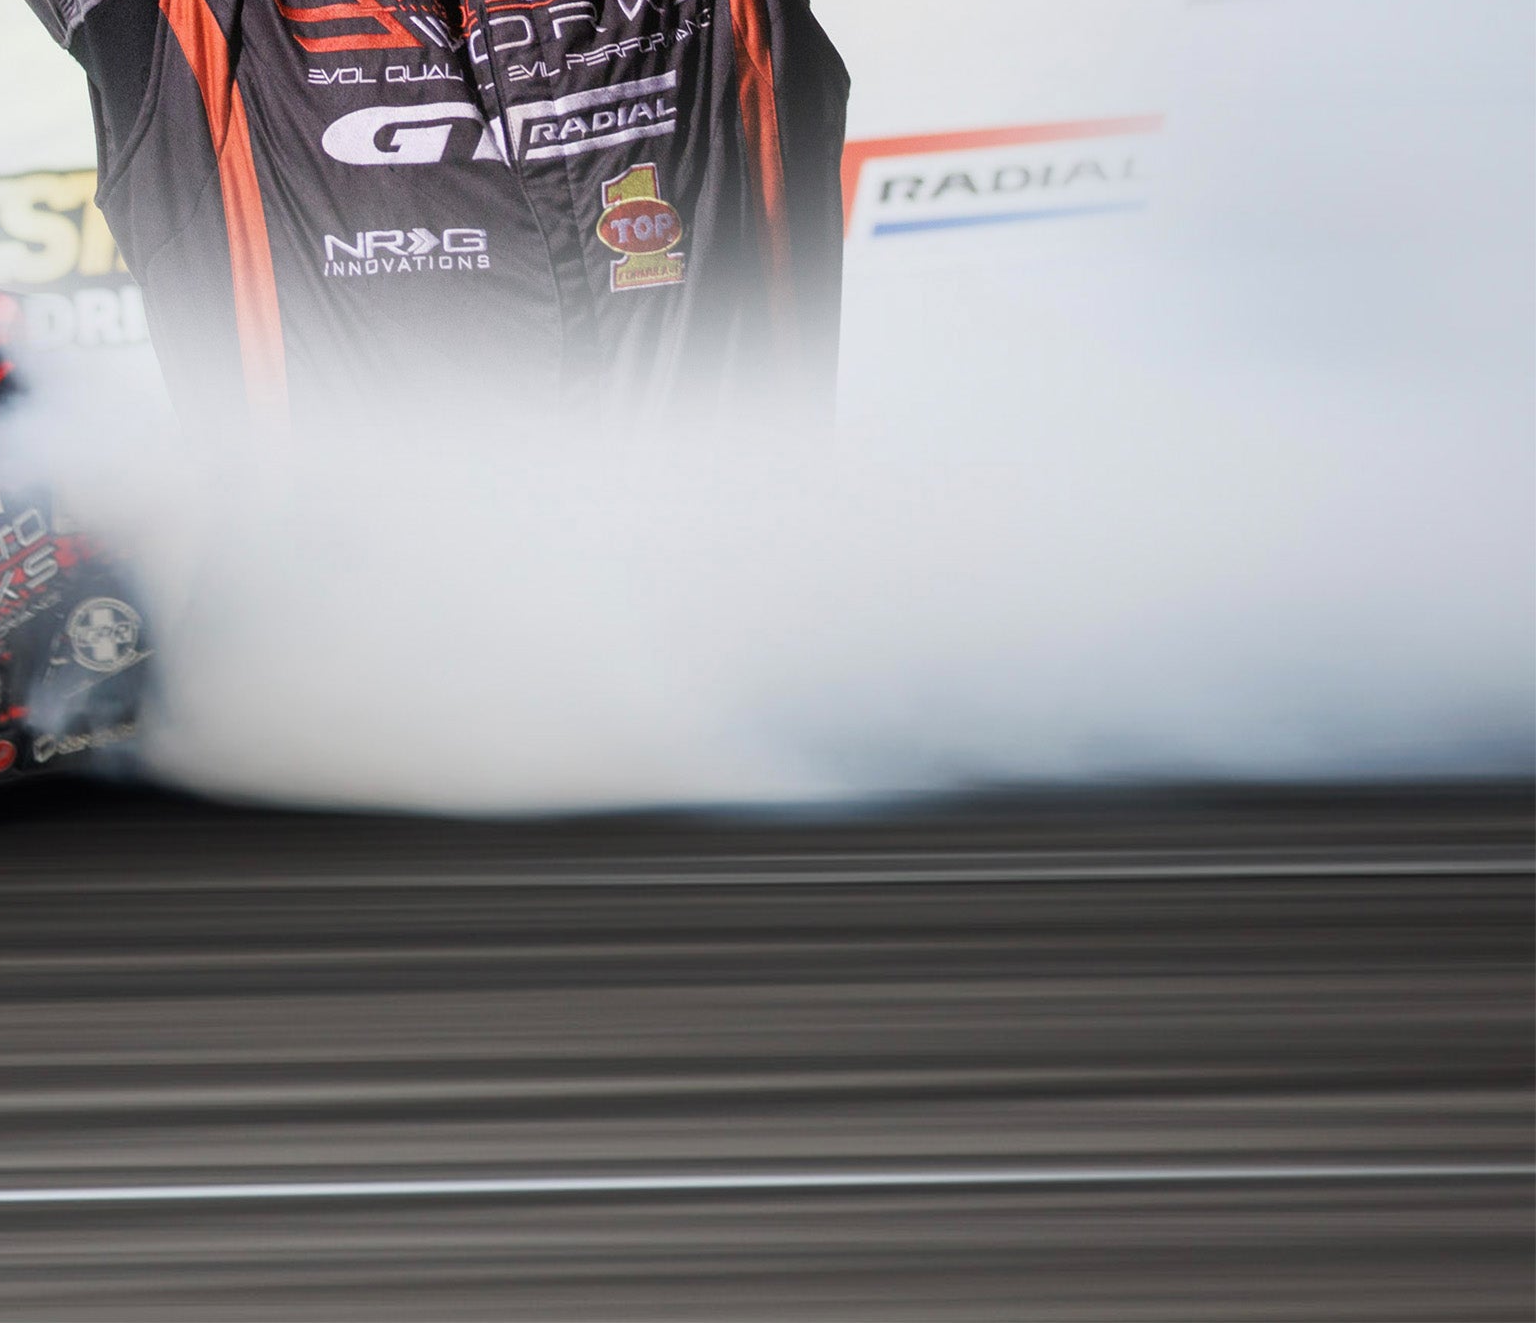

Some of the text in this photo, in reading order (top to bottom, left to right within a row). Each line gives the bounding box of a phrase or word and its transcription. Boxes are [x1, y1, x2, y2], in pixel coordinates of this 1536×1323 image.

[307, 67, 377, 84] EVOL
[529, 97, 677, 144] RADIAL
[611, 213, 673, 244] TOP
[324, 255, 491, 277] INNOVATIONS
